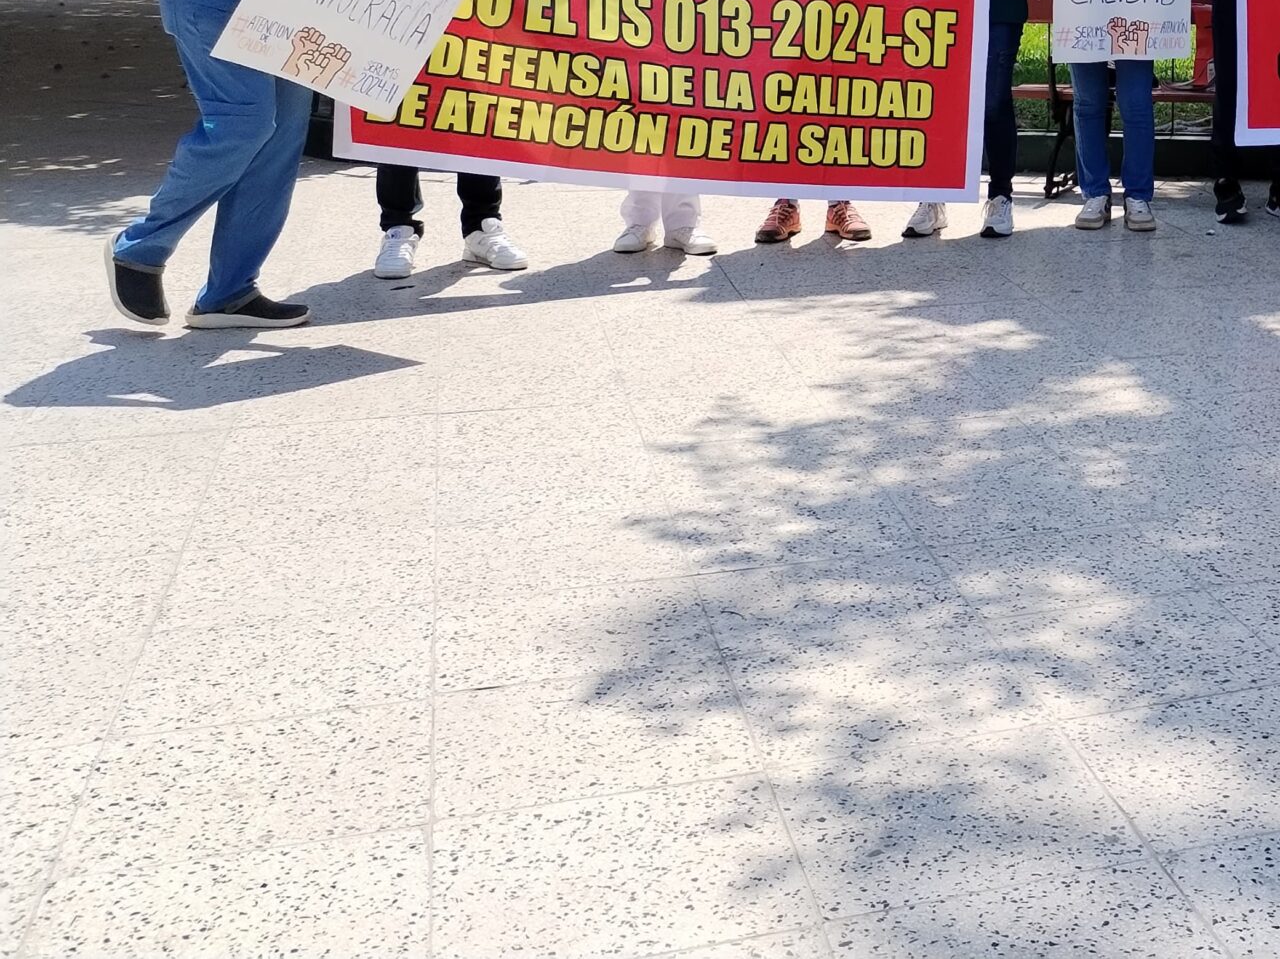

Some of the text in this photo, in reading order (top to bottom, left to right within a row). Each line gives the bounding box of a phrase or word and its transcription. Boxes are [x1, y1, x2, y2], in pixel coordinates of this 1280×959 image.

[427, 33, 933, 120] DEFENSA DE LA CALIDAD
[432, 88, 669, 155] ATENCIÓN
[675, 115, 733, 160] DE
[740, 121, 789, 162] LA
[797, 123, 926, 169] SALUD
